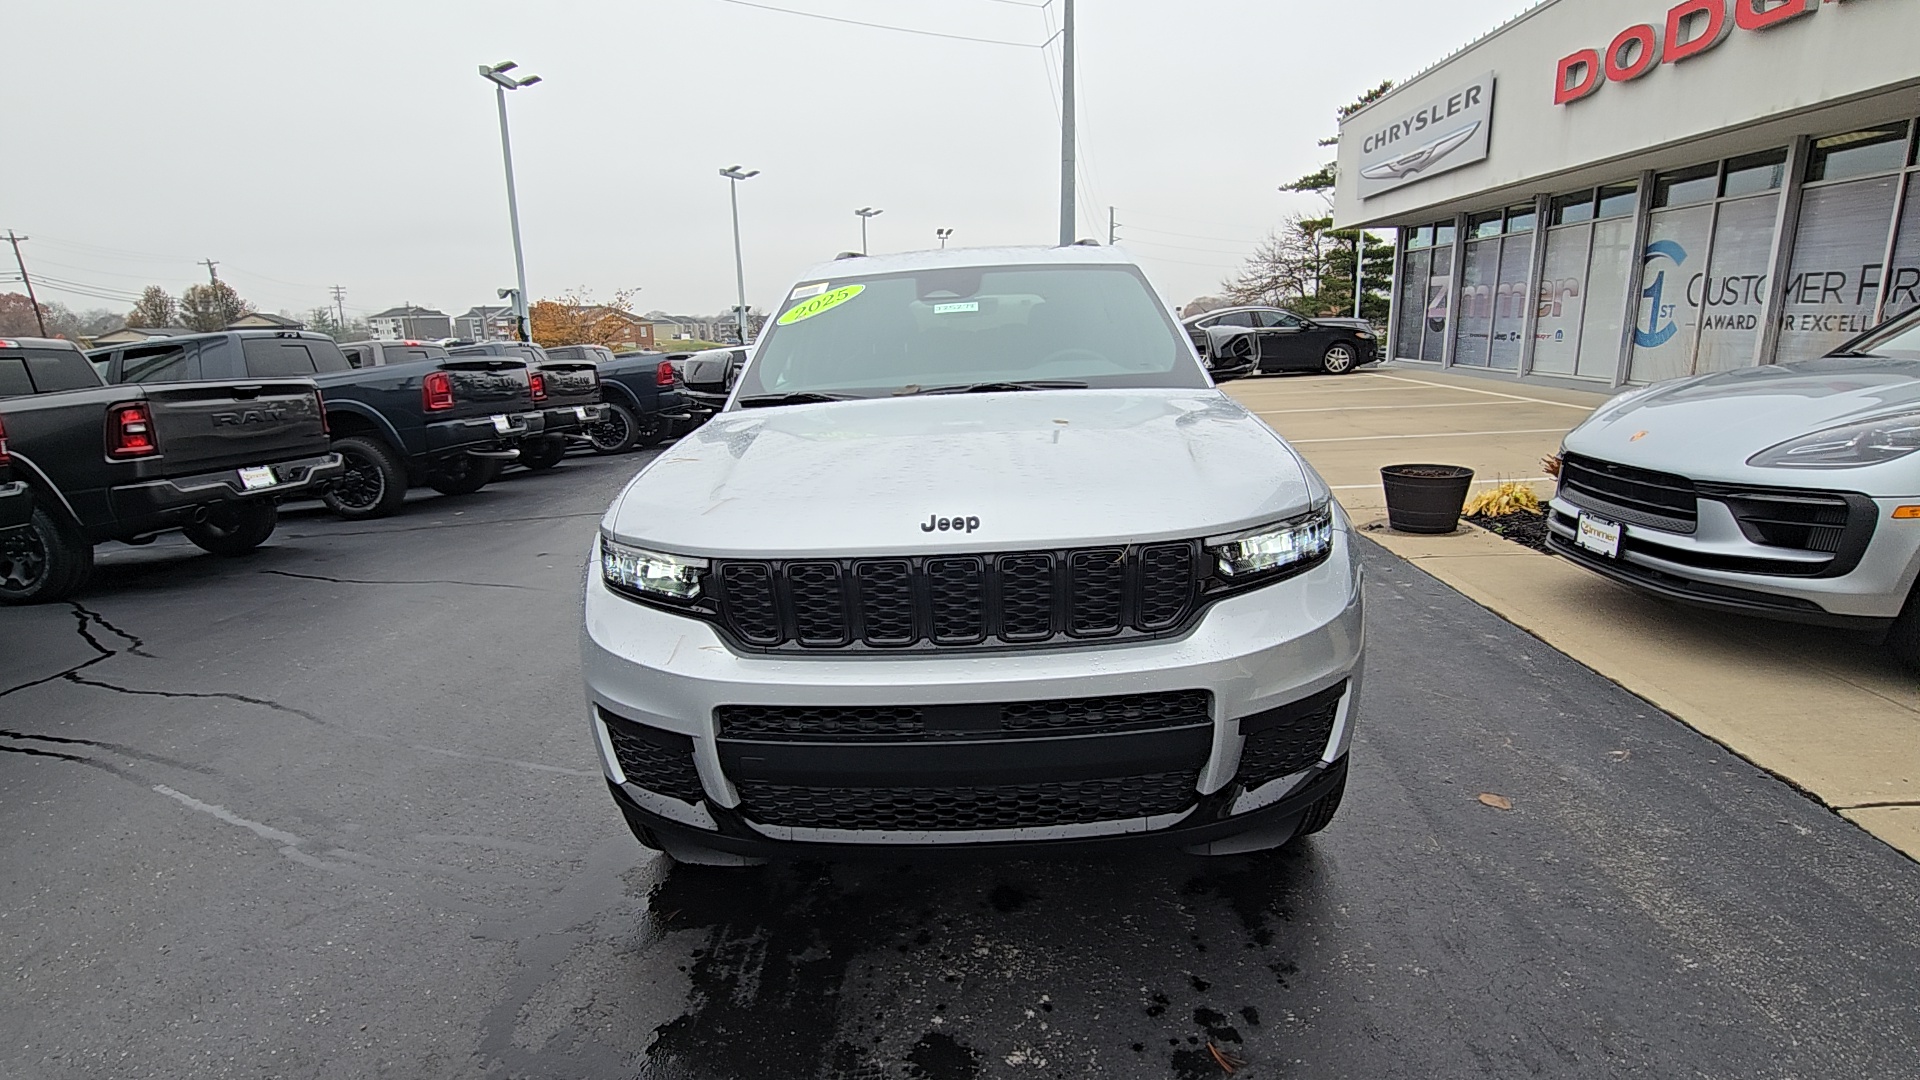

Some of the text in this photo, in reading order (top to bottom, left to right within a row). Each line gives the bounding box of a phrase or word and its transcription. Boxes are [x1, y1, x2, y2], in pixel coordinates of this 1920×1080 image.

[1554, 0, 1820, 104] DOD
[1363, 85, 1482, 154] CHRYSLER
[1427, 275, 1580, 318] Zmmer
[1856, 263, 1920, 305] FIR
[794, 288, 849, 320] 2025
[1703, 314, 1757, 330] AWARD
[1801, 314, 1873, 332] EXCELL
[212, 408, 287, 427] RAM
[920, 514, 980, 534] Jeep
